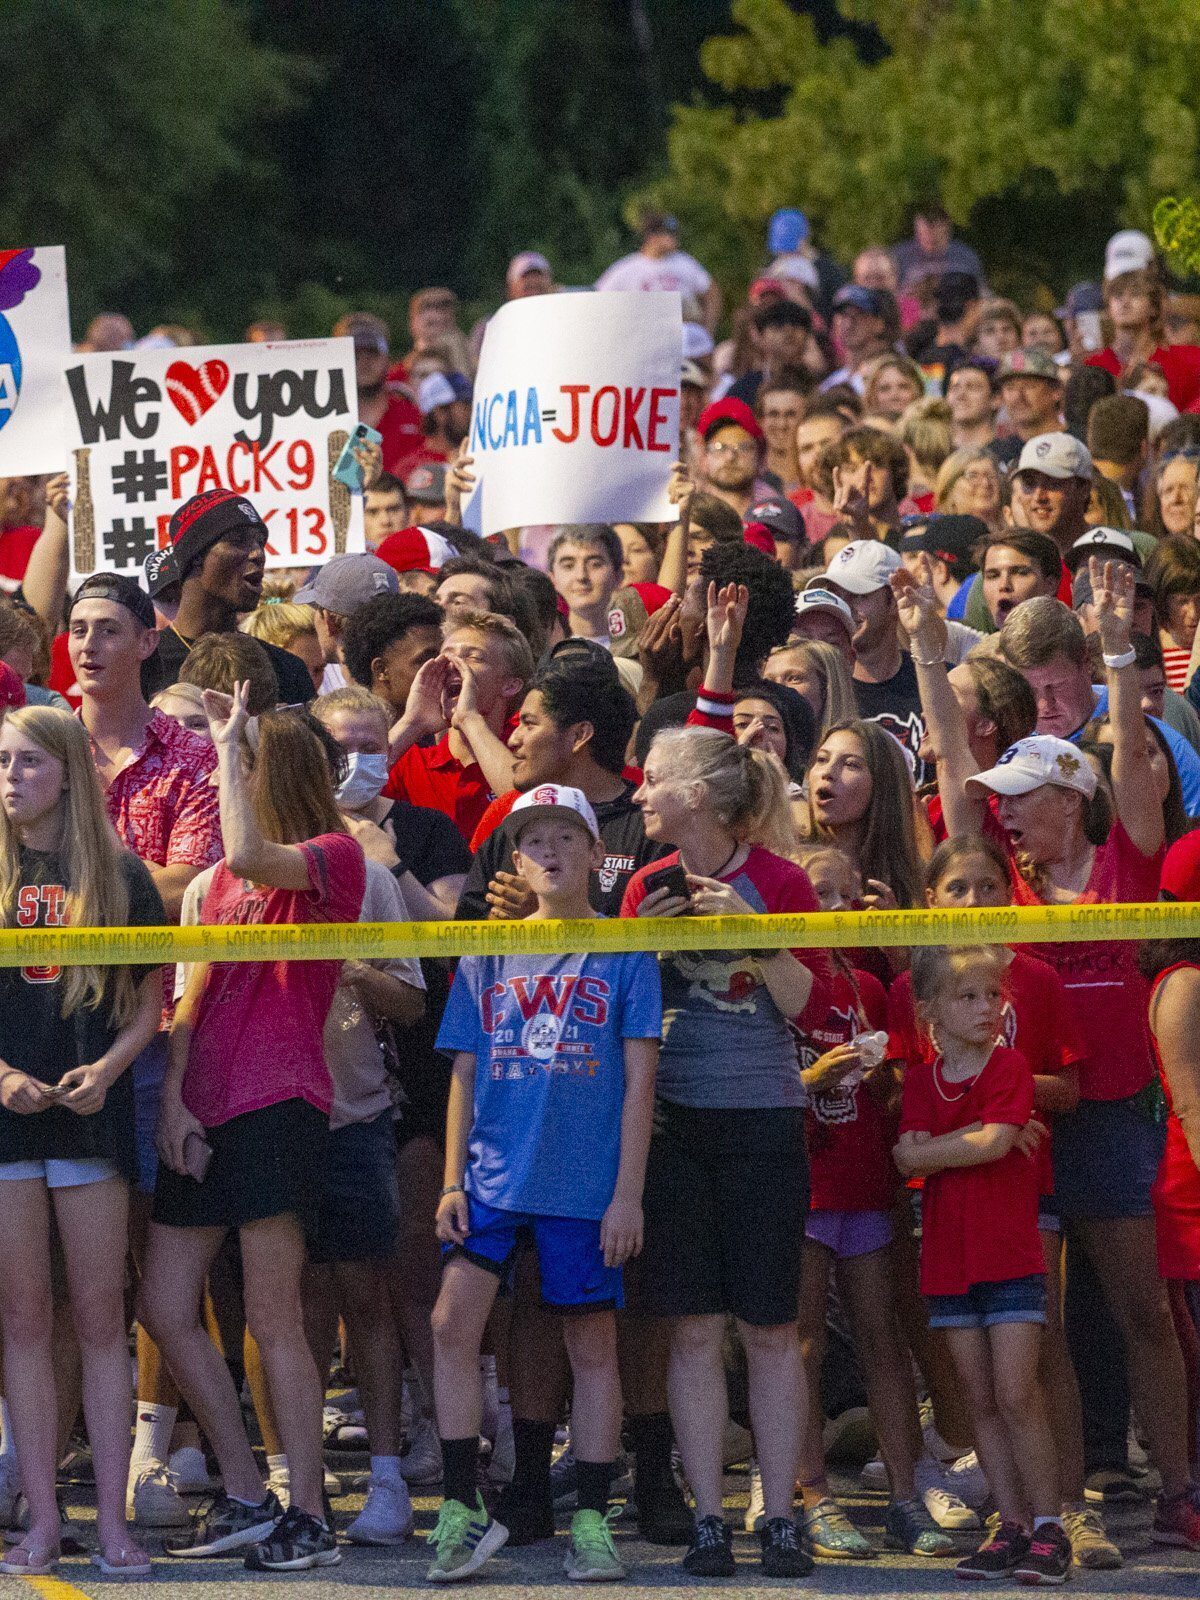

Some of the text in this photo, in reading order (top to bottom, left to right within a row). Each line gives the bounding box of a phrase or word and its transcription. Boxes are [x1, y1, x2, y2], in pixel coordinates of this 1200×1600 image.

[64, 359, 351, 452] We you
[111, 438, 315, 504] #PACK9
[603, 856, 636, 871] STATE
[479, 973, 611, 1035] CWS
[493, 1028, 514, 1044] 20
